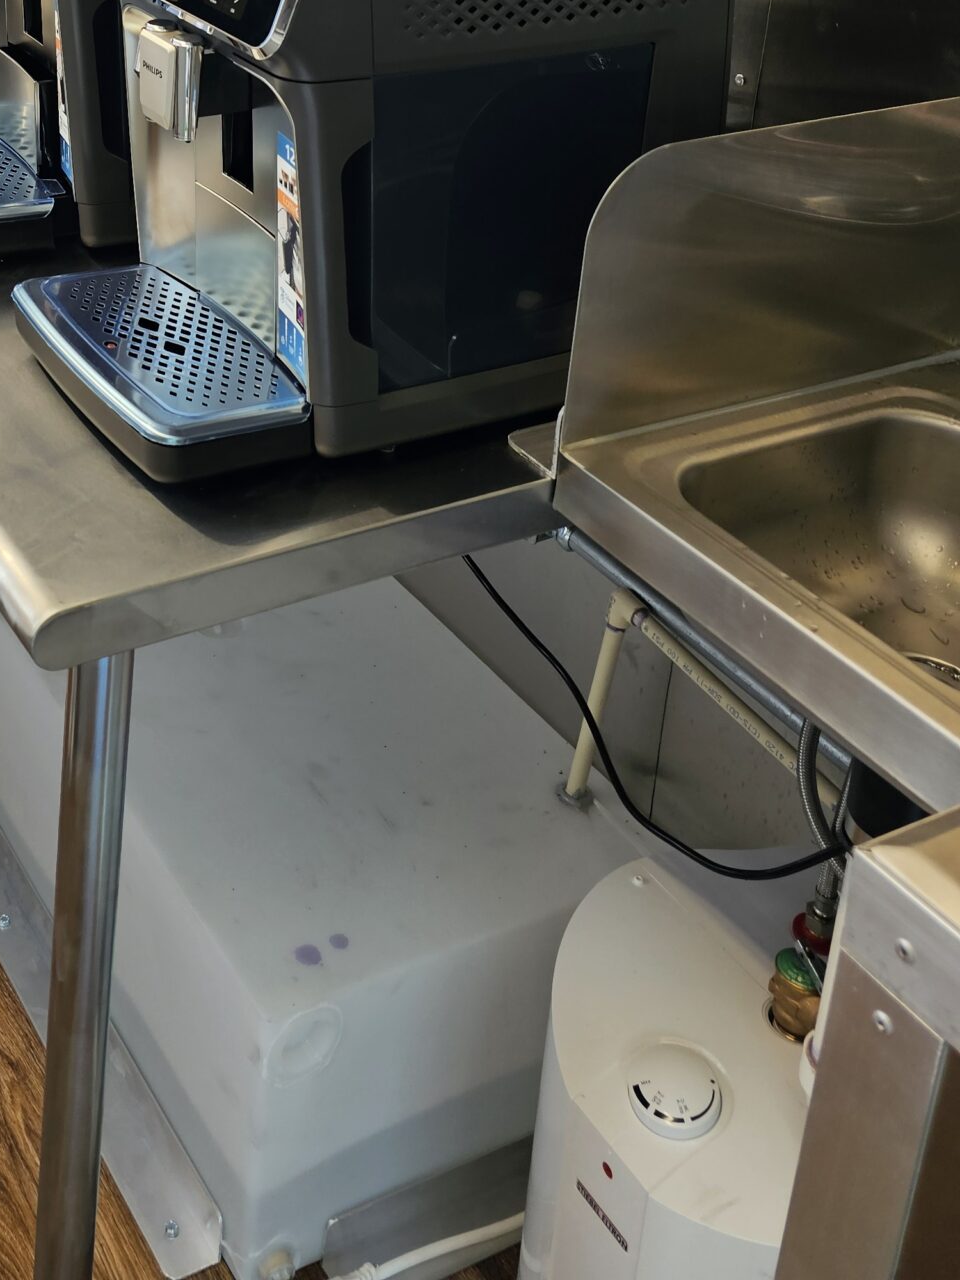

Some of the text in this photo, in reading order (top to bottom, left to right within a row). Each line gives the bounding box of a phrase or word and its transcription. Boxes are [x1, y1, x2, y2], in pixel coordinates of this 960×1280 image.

[143, 59, 163, 79] PHILIPS
[576, 1181, 628, 1252] STIEBEL ELTRON
